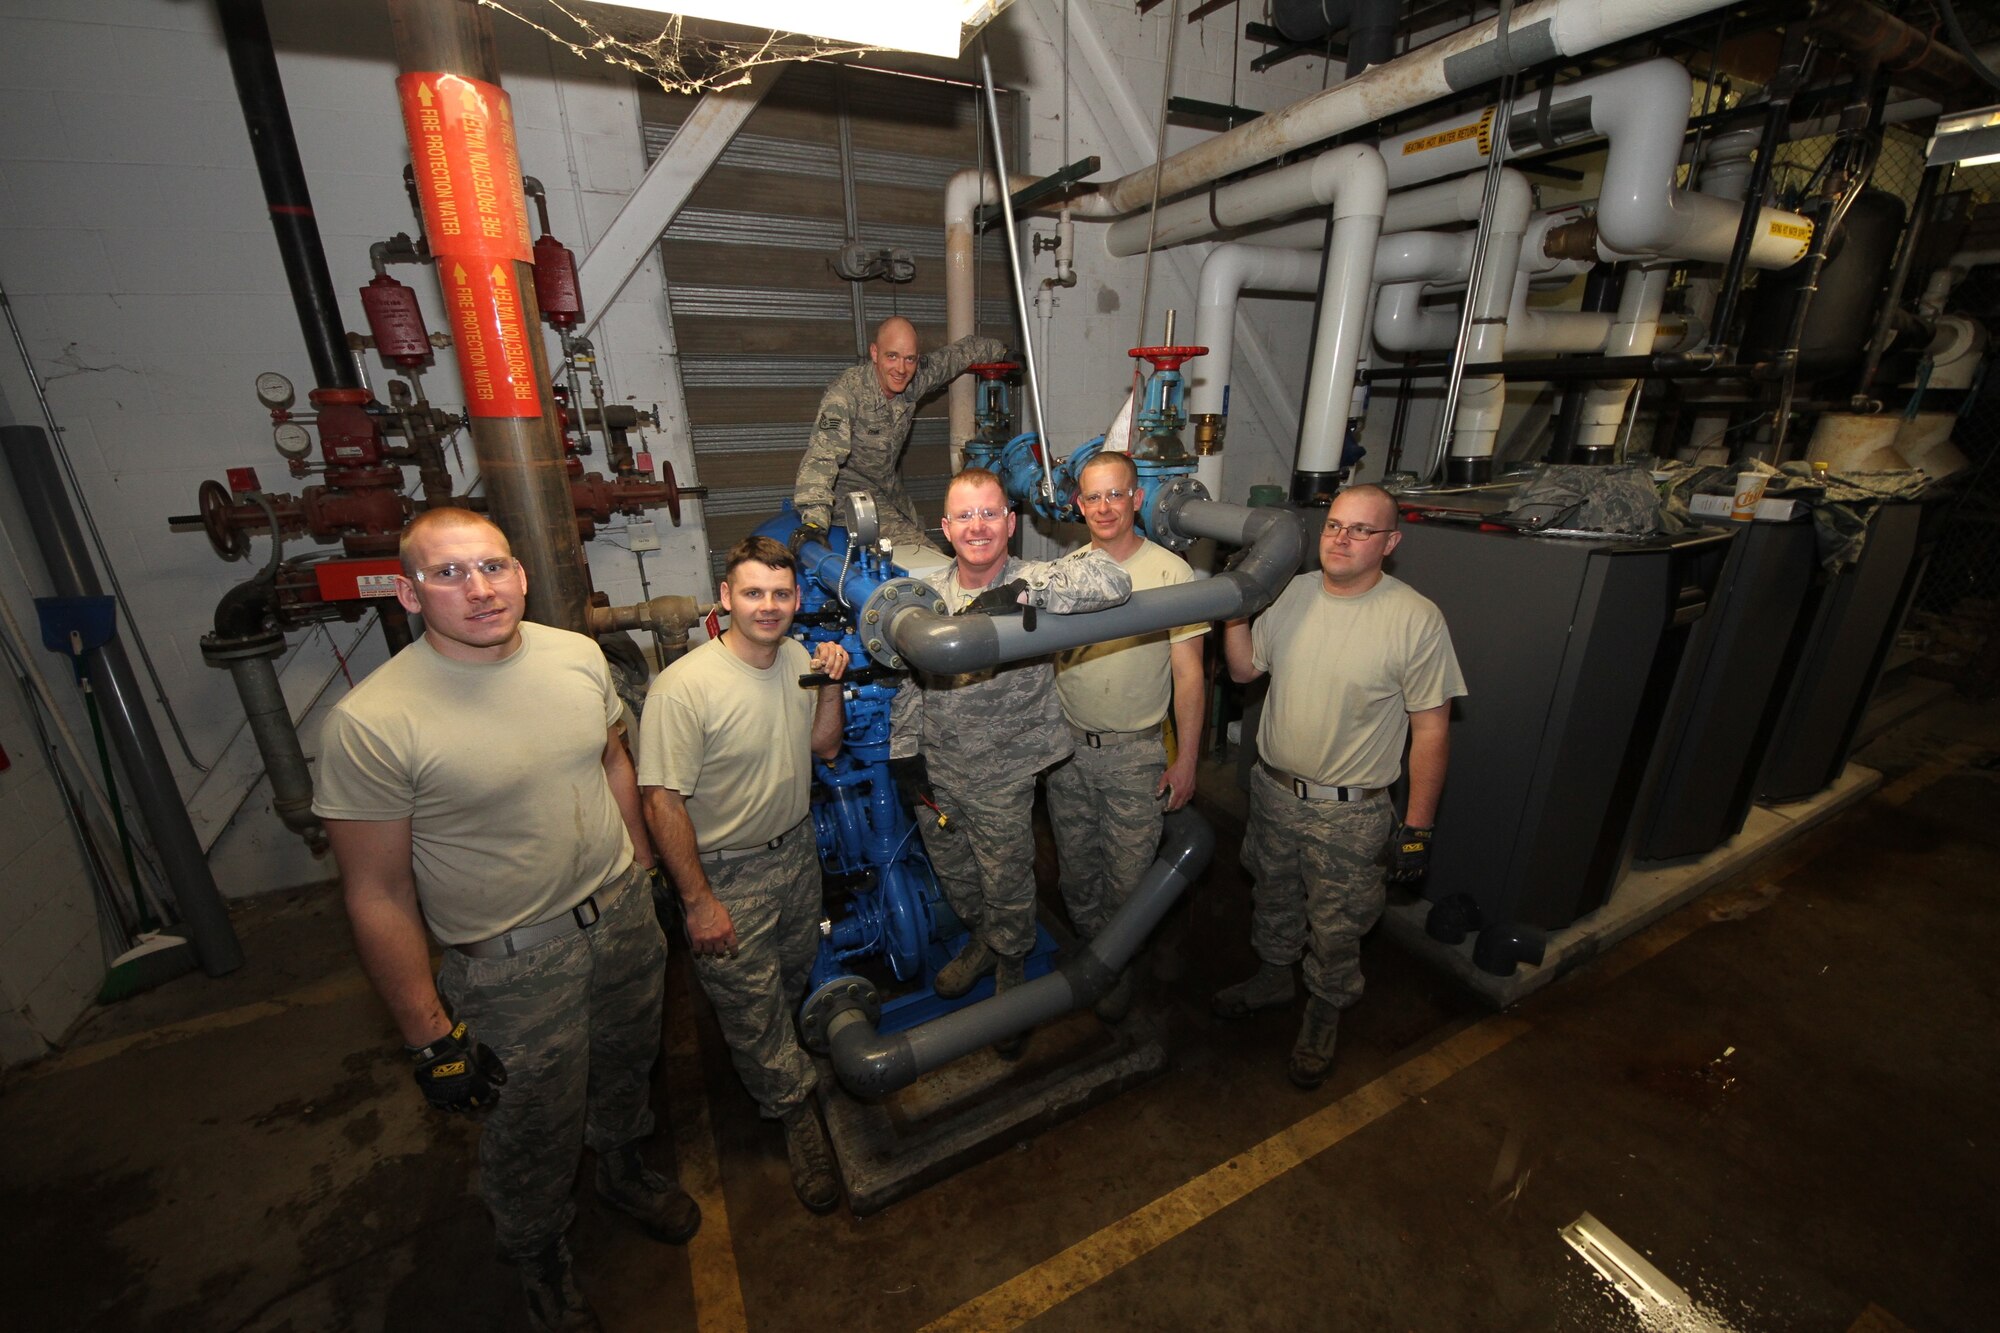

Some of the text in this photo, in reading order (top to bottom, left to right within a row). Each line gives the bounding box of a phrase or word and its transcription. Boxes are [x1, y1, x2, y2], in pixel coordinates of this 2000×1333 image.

[420, 109, 440, 132] FIRE
[501, 123, 515, 145] FIRE
[1404, 127, 1478, 153] HEATING HOT WATER RETURN
[425, 135, 454, 198] PROTECTION
[462, 112, 503, 238] FIRE PROTECTION WATER
[438, 201, 461, 236] WATER
[456, 287, 495, 400] FIRE PROTECTION WATER
[494, 288, 533, 400] FIRE PROTECTION WATER
